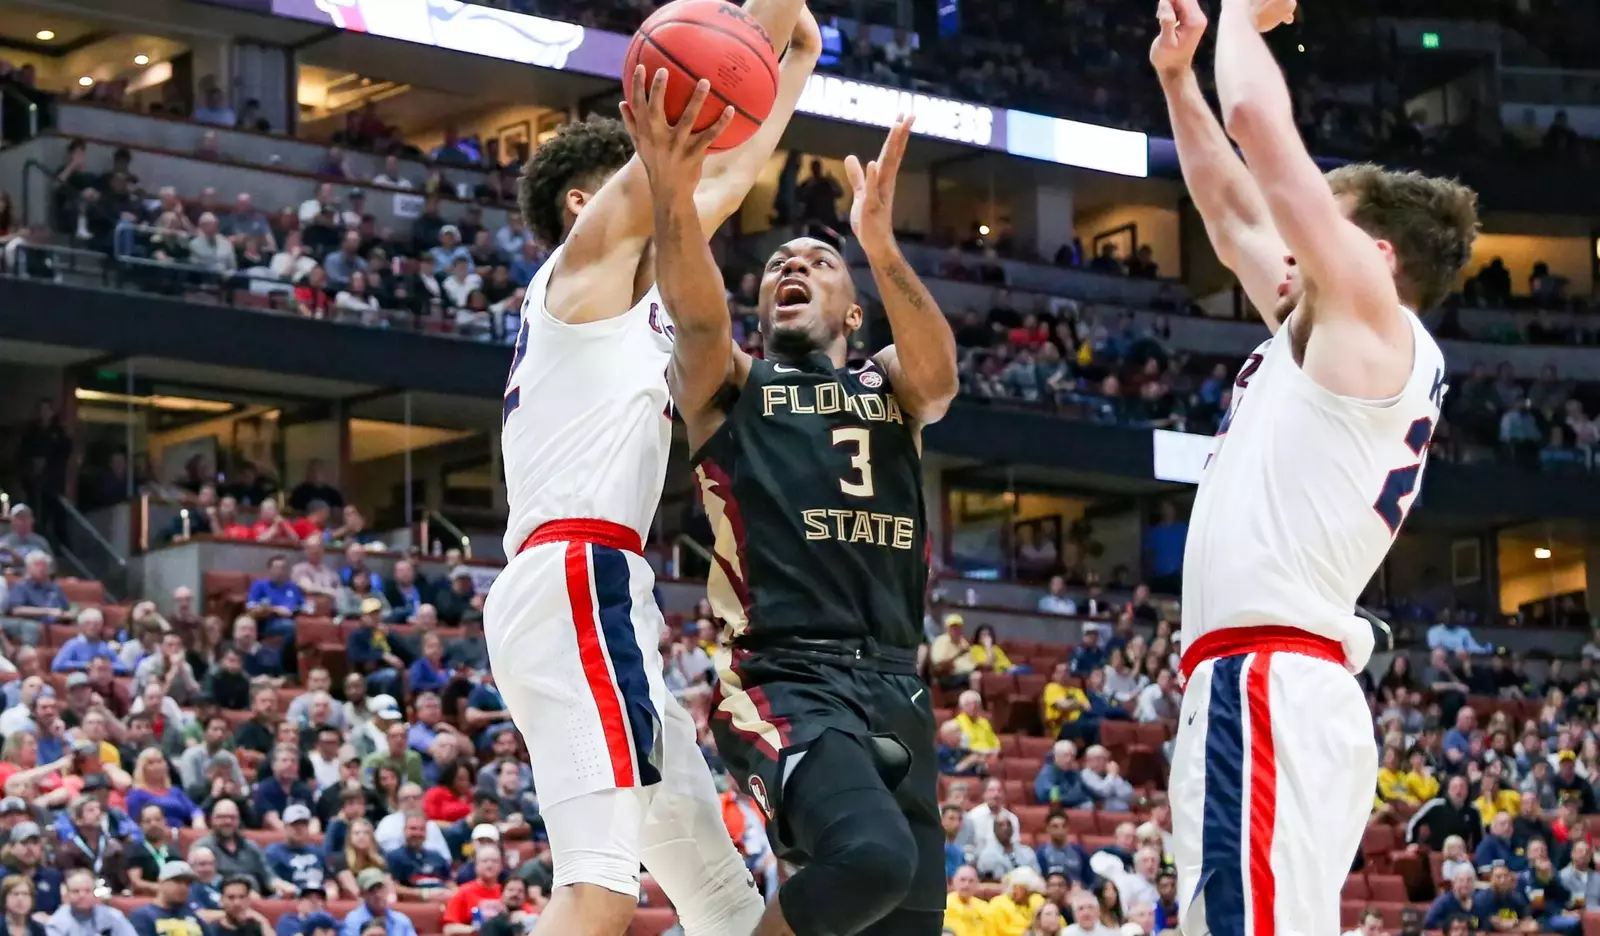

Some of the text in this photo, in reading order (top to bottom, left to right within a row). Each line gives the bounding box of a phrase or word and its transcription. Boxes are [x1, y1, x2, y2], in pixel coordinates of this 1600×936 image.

[795, 74, 993, 145] ARCHMADNESS
[832, 427, 874, 497] 3
[801, 508, 914, 550] STATE
